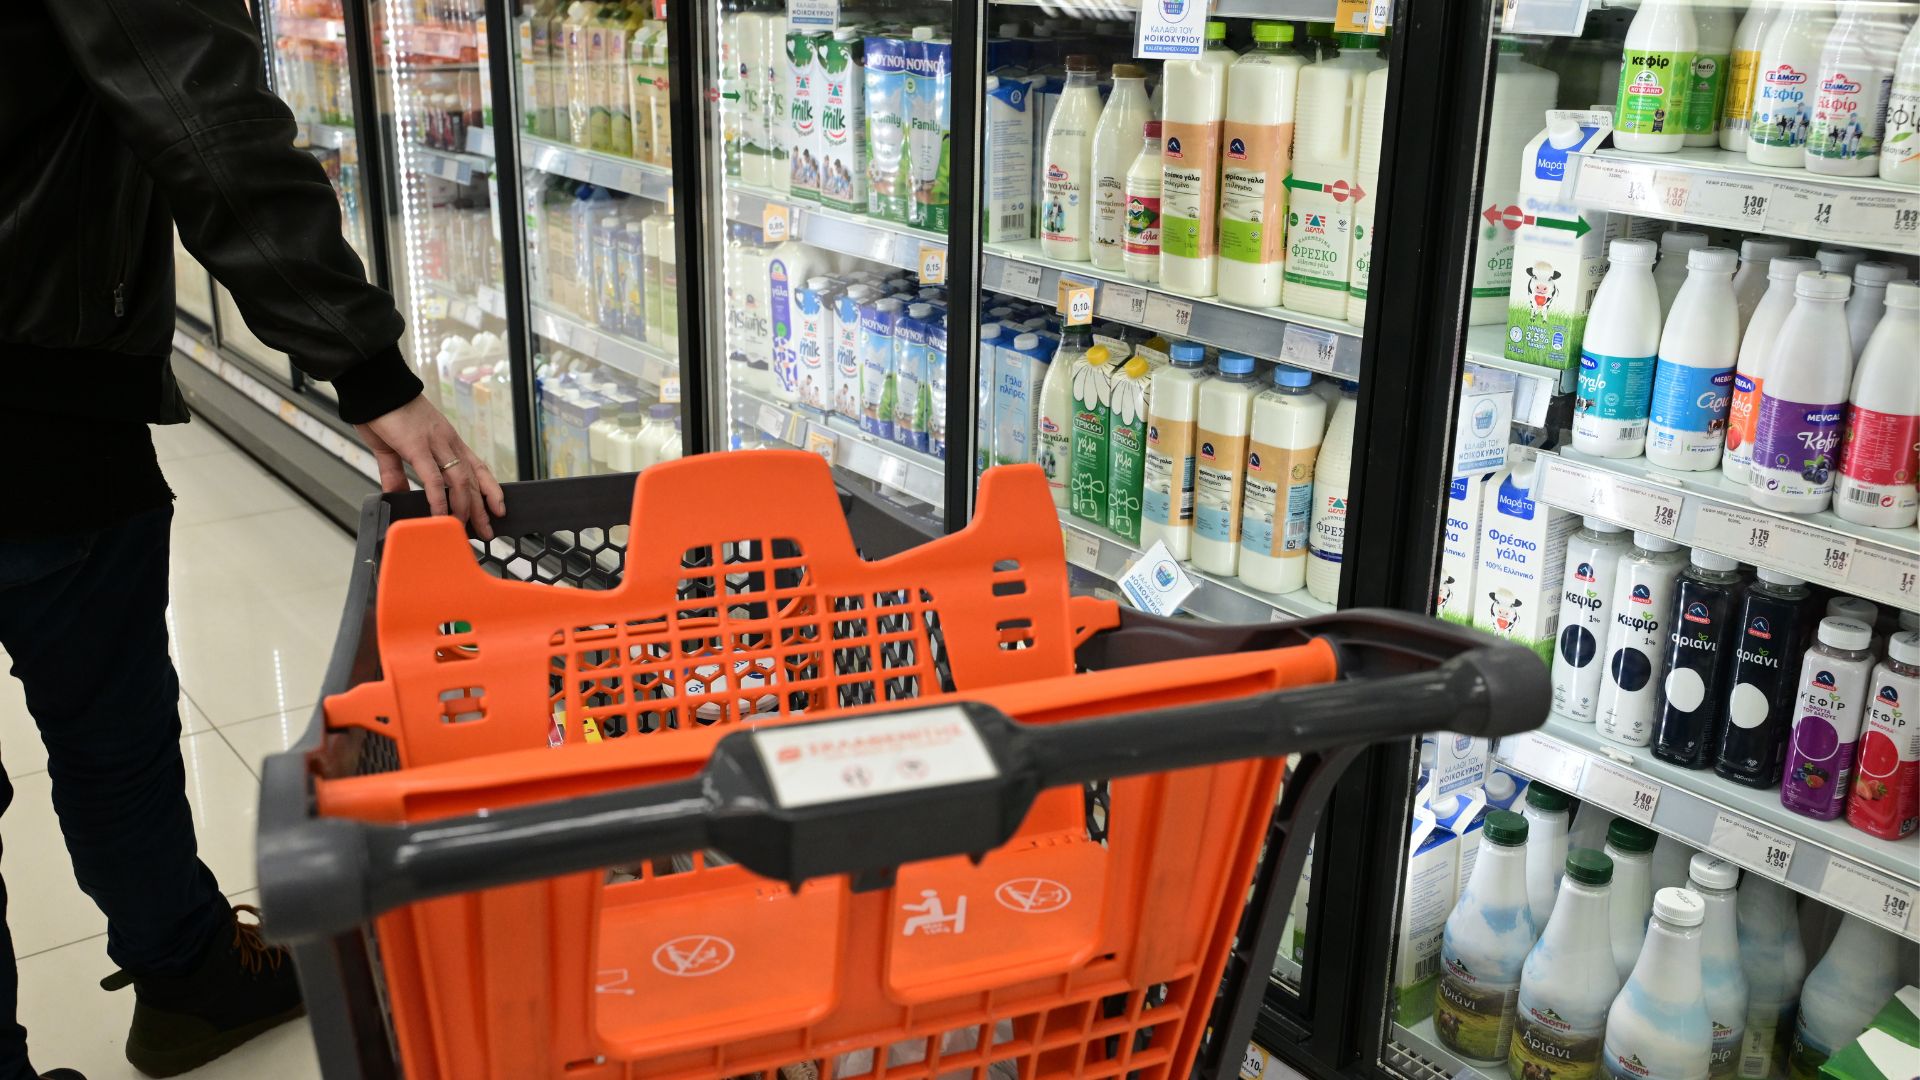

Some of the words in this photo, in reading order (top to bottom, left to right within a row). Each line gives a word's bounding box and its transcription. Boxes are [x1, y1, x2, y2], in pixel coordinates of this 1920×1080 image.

[1151, 25, 1178, 34] ΚΑΛΑΘΙ
[1144, 34, 1200, 43] ΝΟΙΚΟΚΥΡΙΟΥ
[1632, 54, 1670, 69] κεφίρ
[792, 100, 813, 122] milk
[1817, 96, 1857, 113] Κεφίρ
[823, 107, 845, 130] milk
[912, 117, 941, 135] Family
[1184, 174, 1200, 182] γάλα
[1247, 176, 1264, 184] γάλα
[1305, 227, 1325, 235] ΔΕΛΤΑ
[1291, 243, 1337, 262] ΦΡΕΣΚΟ
[1487, 257, 1512, 271] ΦΡΕ
[1526, 332, 1549, 344] 3,5%
[799, 339, 820, 358] milk
[837, 349, 857, 366] milk
[865, 358, 885, 375] Family
[1075, 418, 1102, 434] ΤΡΙΚΚΗ
[1806, 413, 1841, 422] MEVGAL
[1078, 435, 1097, 452] γάλα
[1112, 433, 1138, 450] ΤΡΙΚΚΗ
[1797, 430, 1840, 452] Kefir
[1115, 450, 1132, 467] γάλα
[1500, 494, 1533, 511] Μαράτα
[1316, 520, 1344, 537] ΦΡΕΣ
[1489, 528, 1536, 552] Φρέσκο
[1496, 546, 1526, 564] γάλα
[1503, 565, 1534, 580] Ελληνικό
[1129, 574, 1160, 615] ΝΟΙΚΟΚΥΡΙΟ
[1588, 614, 1600, 623] 1%
[1644, 637, 1656, 646] 1%
[1800, 691, 1845, 710] ΚΕΦΙΡ
[1865, 704, 1906, 728] ΚΕΦΙΡ
[1467, 757, 1478, 766] ΤΟΥ
[1440, 763, 1484, 783] ΝΟΙΚΟΚΥΡΙΟΥ
[1440, 978, 1476, 1010] Αριάνι
[1523, 1030, 1571, 1059] Αριάνι
